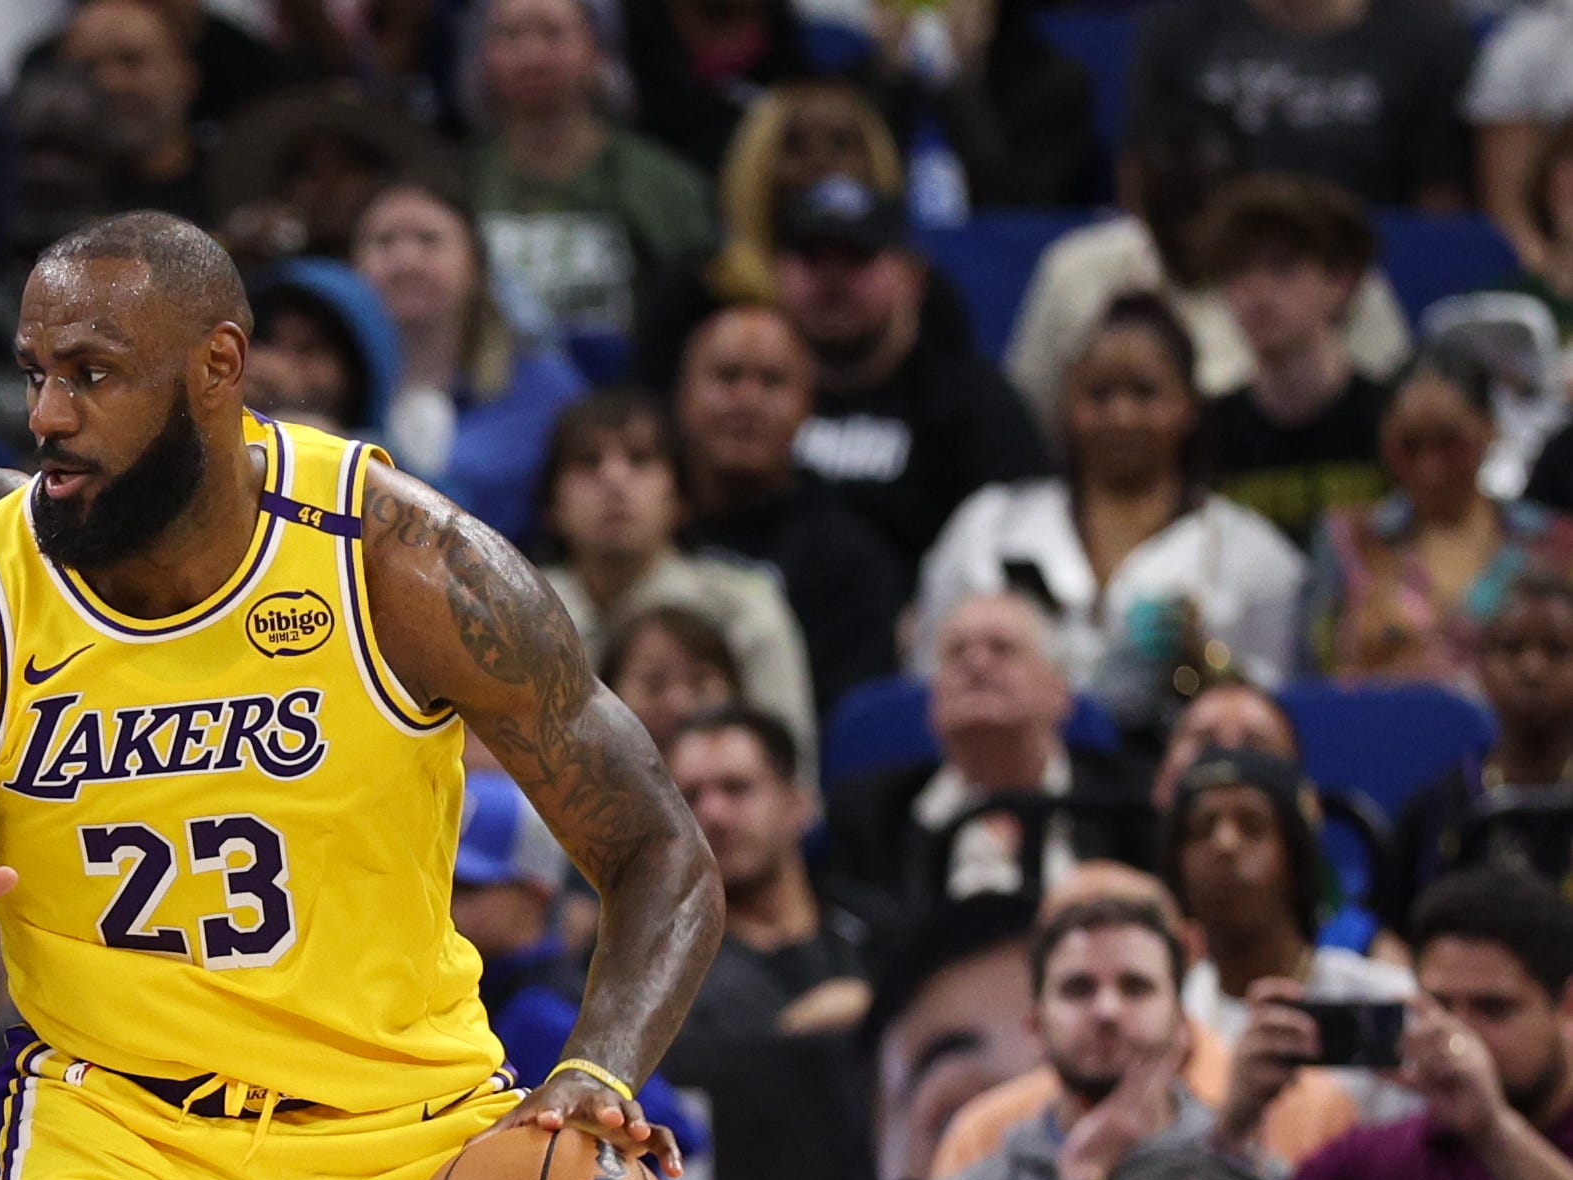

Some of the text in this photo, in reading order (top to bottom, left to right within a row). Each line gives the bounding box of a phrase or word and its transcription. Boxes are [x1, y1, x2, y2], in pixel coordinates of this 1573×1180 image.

[297, 506, 323, 528] 44
[253, 608, 329, 635] bibigo
[268, 631, 300, 644] 비비고
[3, 688, 329, 800] LAKERS
[77, 813, 297, 969] 23
